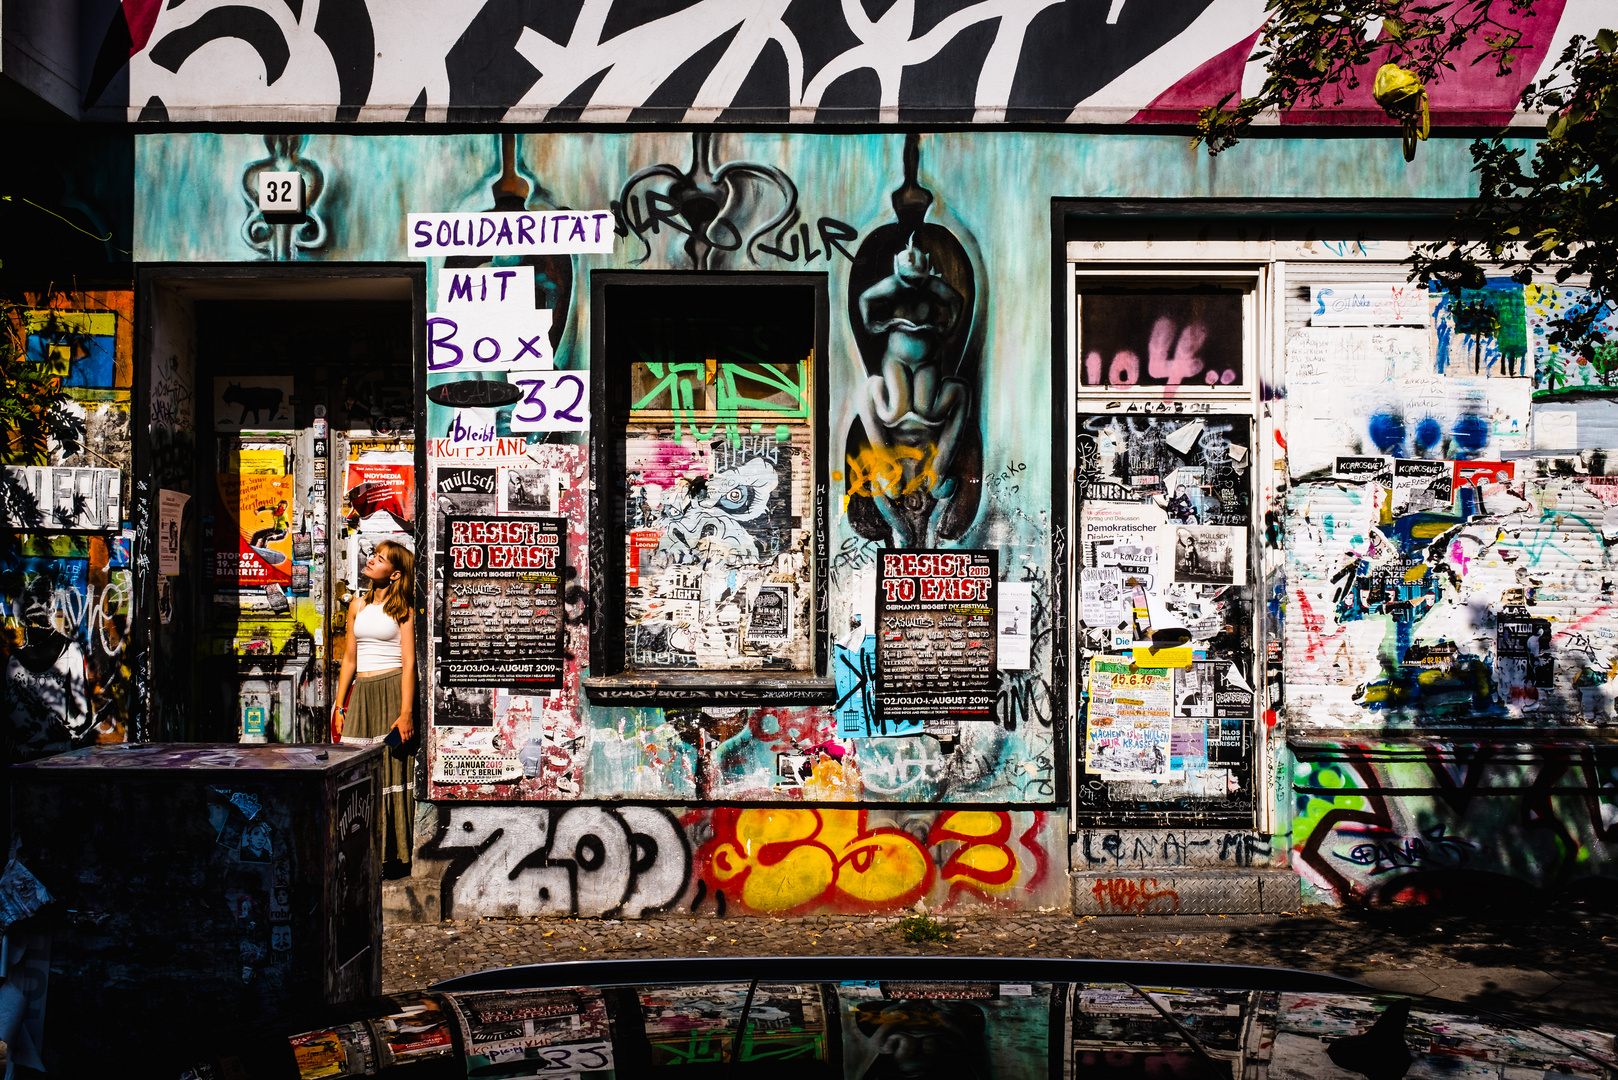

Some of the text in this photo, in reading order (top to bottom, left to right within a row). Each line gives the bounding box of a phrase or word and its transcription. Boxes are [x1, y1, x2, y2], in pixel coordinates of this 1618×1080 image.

[267, 181, 292, 202] 32
[414, 214, 608, 247] SOLIDARITÄT
[448, 271, 517, 303] MIT
[515, 375, 585, 423] 32
[453, 411, 495, 443] bleibt
[439, 470, 494, 493] müllsch
[452, 521, 539, 544] RESIST
[1087, 524, 1157, 532] Demokratischer
[537, 535, 558, 544] 2019
[450, 545, 560, 569] TO EXIST
[884, 554, 971, 577] RESIST
[1120, 554, 1152, 562] KONZERT
[969, 565, 990, 577] 2019
[882, 578, 992, 602] TO EXIST
[1115, 637, 1130, 645] Die
[499, 664, 534, 672] AUGUST
[535, 664, 556, 672] 2019
[932, 697, 967, 705] AUGUST
[969, 697, 989, 705] 2019
[1090, 729, 1121, 742] MACHEN
[1123, 739, 1165, 750] KRASSER
[456, 761, 486, 769] JANUAR
[479, 768, 503, 776] BERLIN
[338, 789, 374, 842] müllsch
